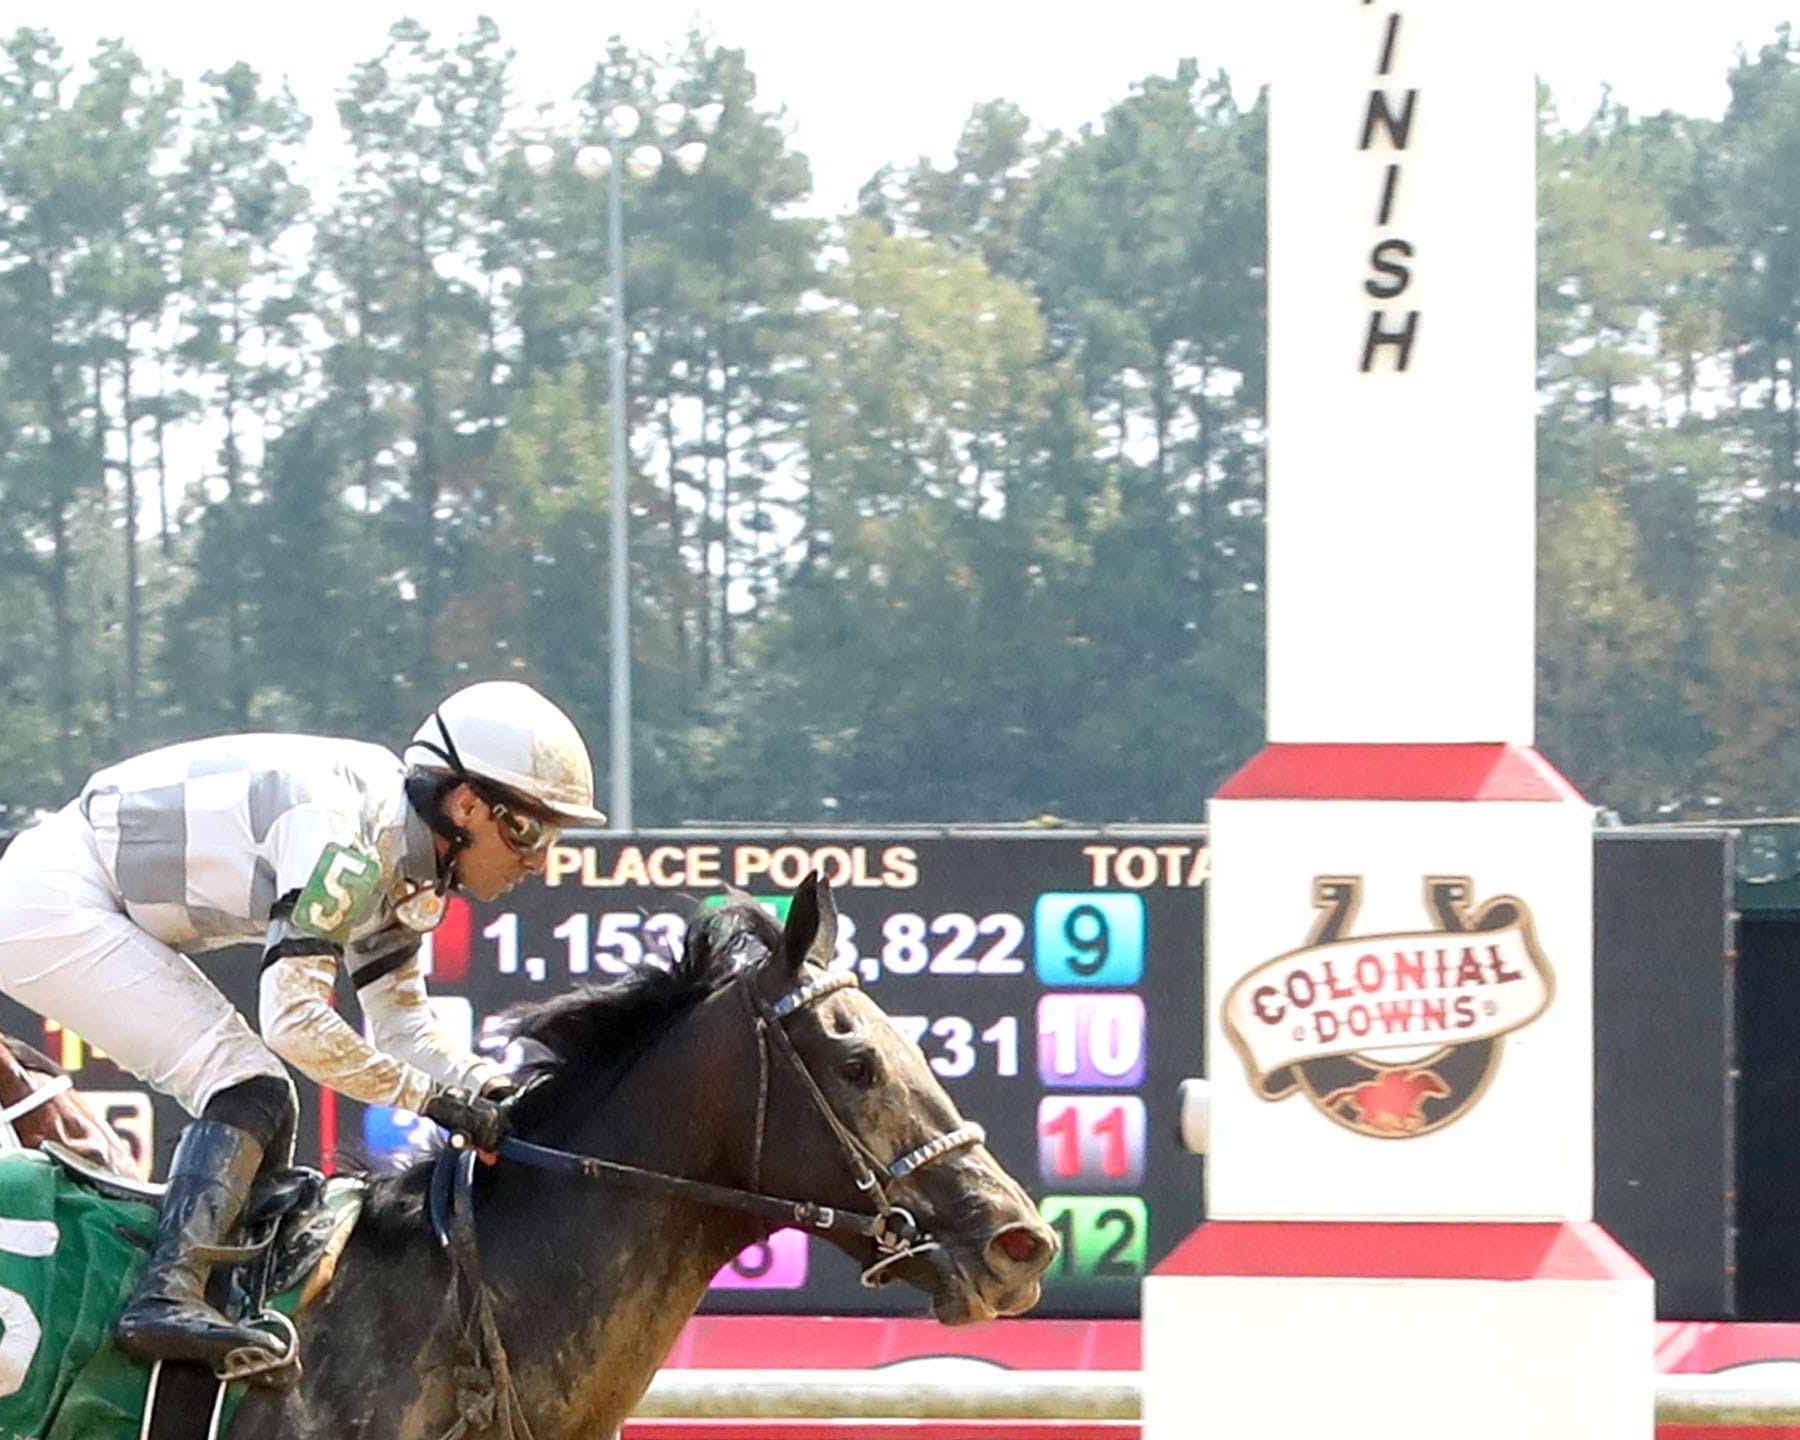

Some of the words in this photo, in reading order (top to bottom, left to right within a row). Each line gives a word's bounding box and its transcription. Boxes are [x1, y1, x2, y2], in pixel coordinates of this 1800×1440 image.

[1357, 0, 1421, 373] INISH
[308, 852, 368, 931] 5
[545, 846, 719, 888] PLACE
[731, 846, 918, 888] POOLS
[1065, 905, 1110, 975] 9
[1253, 945, 1524, 1025] COLONIAL
[1039, 1003, 1138, 1078] 10
[1042, 1111, 1132, 1178] 11
[1050, 1208, 1137, 1278] 12
